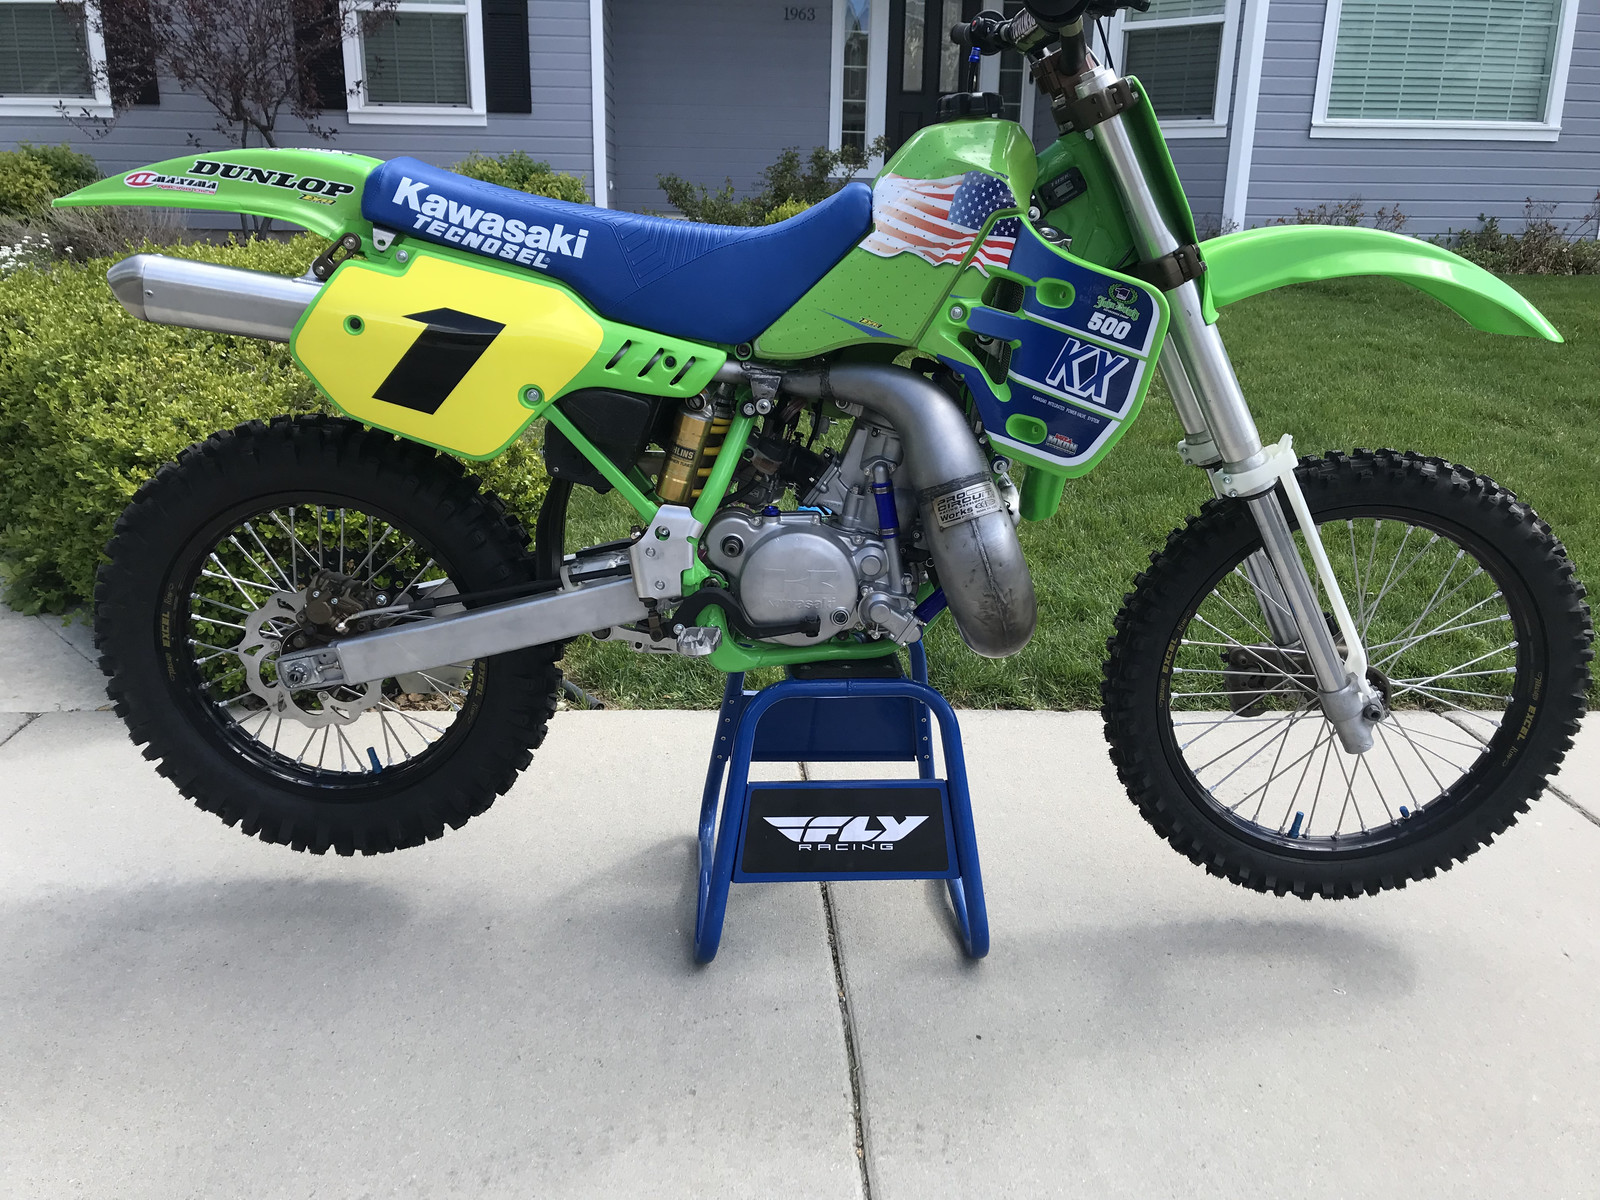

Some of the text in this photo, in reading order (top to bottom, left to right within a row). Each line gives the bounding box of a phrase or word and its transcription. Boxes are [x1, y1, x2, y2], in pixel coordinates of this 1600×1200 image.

[784, 7, 815, 21] 1963
[151, 176, 217, 190] MAXIMA
[189, 160, 354, 196] DUNLOP
[392, 176, 589, 259] Kawasaki
[413, 214, 549, 269] TECNOSEL
[1087, 311, 1132, 340] 500
[371, 307, 507, 415] 1
[1045, 337, 1129, 405] KX
[938, 492, 966, 506] PRO
[940, 507, 974, 522] Works
[1161, 637, 1178, 674] EXCEL
[1517, 704, 1537, 740] EXCEL
[763, 815, 930, 842] FLY
[798, 843, 894, 851] RACING
